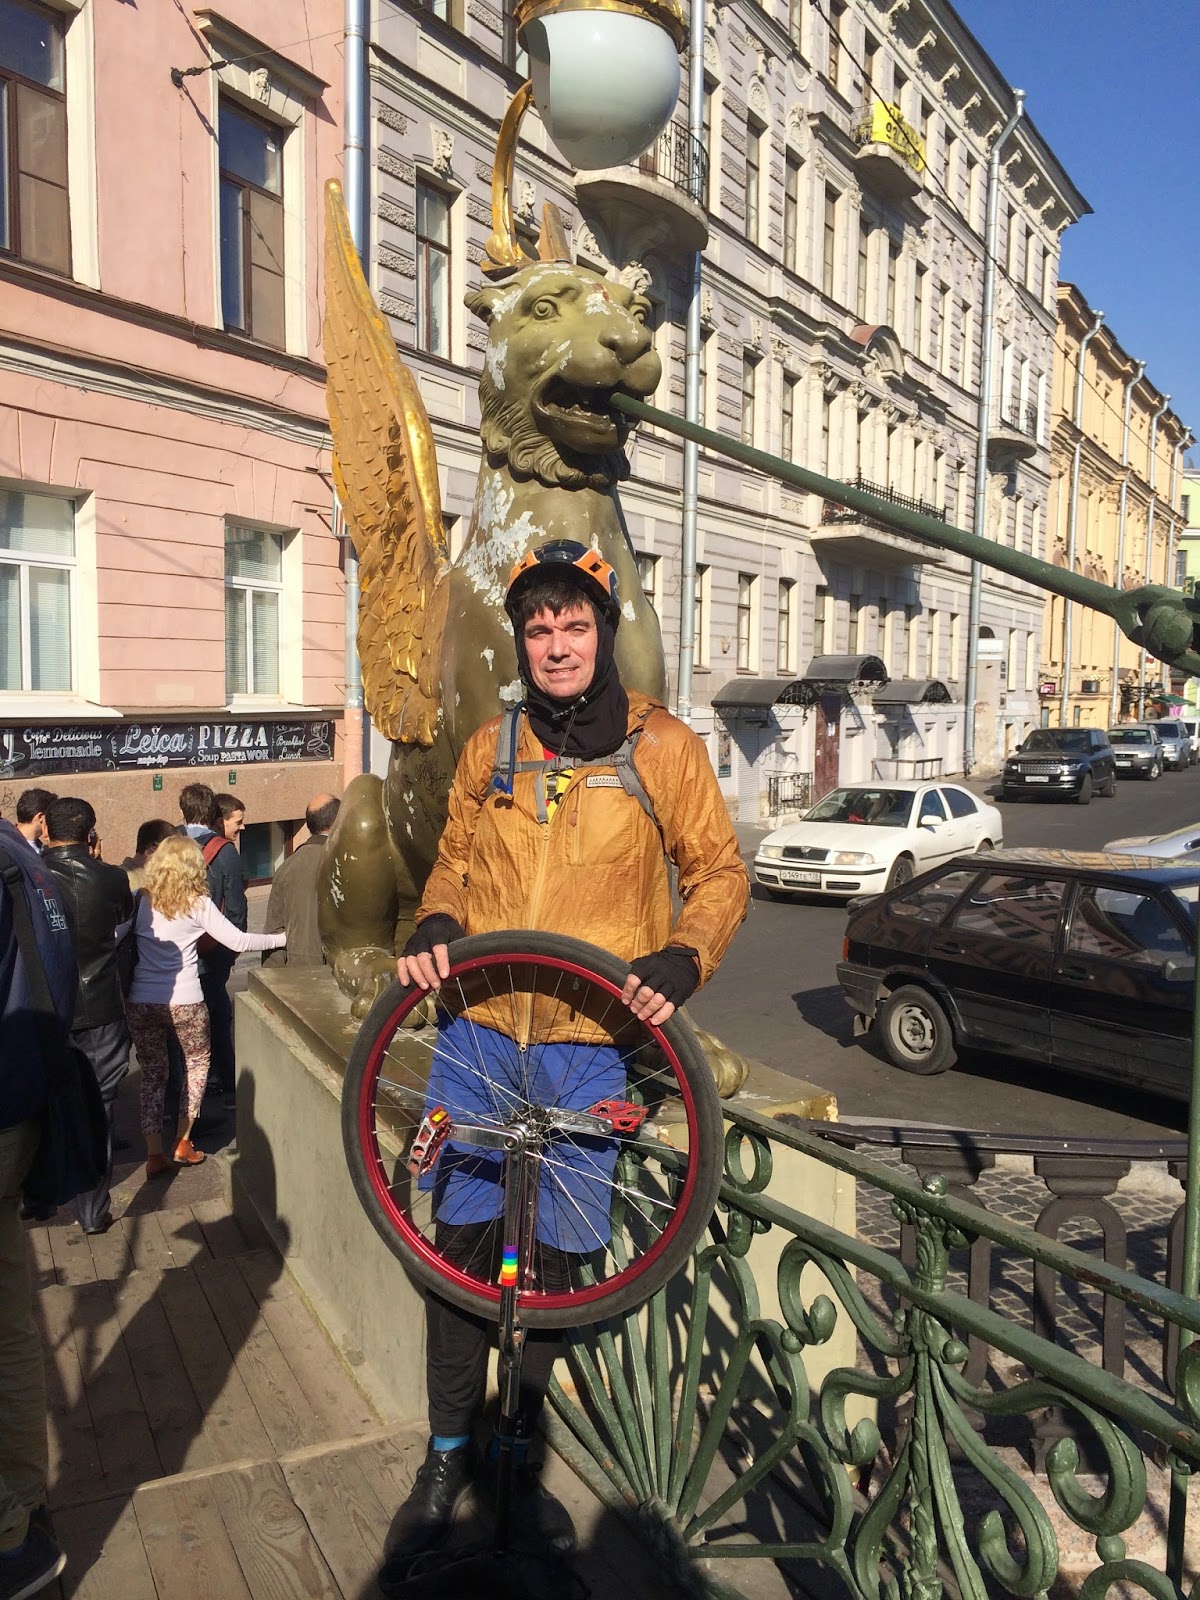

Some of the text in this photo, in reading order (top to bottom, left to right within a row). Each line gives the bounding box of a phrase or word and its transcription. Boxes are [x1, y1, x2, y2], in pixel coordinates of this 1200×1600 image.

[52, 727, 103, 742] Delicious
[119, 725, 187, 754] Leica
[197, 724, 268, 749] PIZZA
[29, 741, 102, 759] lemonade
[197, 749, 269, 765] Soup PASTA WOK
[279, 746, 303, 760] Lunch
